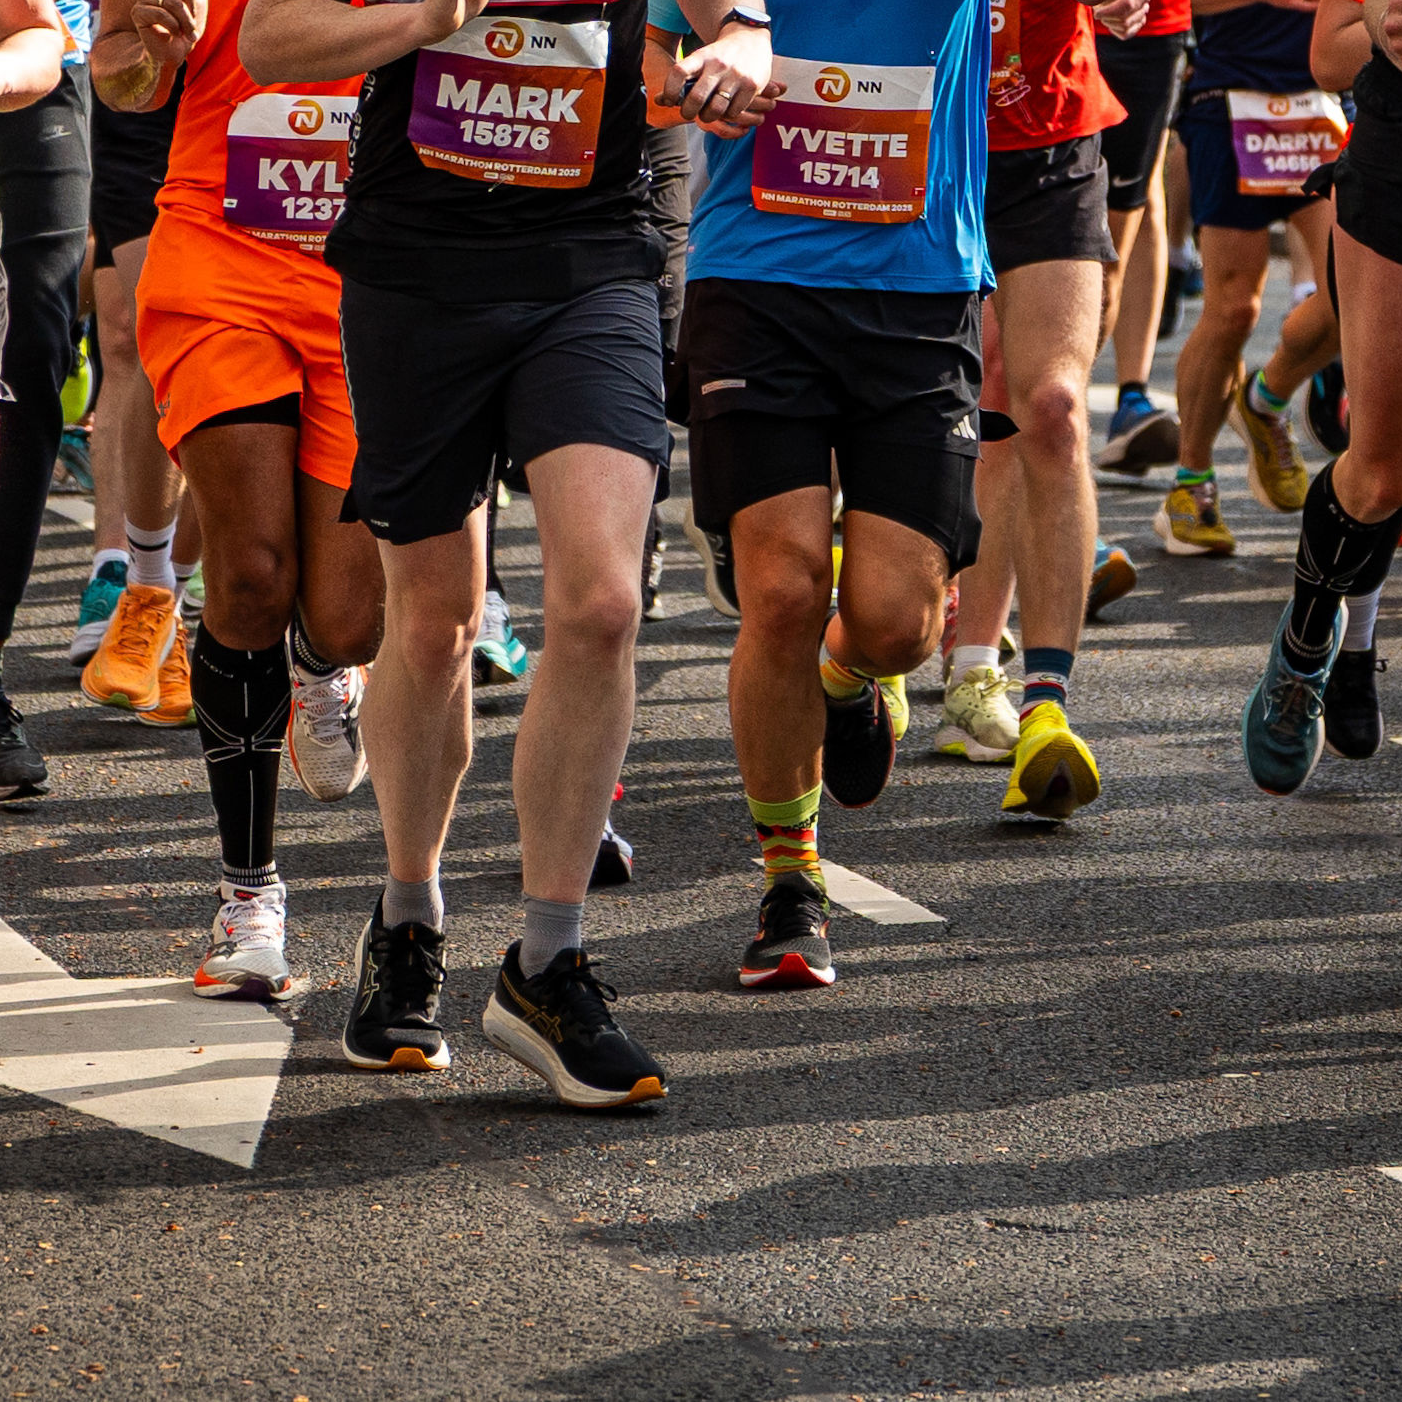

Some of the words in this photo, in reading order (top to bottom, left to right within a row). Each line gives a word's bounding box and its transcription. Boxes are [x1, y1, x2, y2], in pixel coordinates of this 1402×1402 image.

[530, 36, 557, 49] NN
[436, 73, 583, 123] MARK
[857, 80, 882, 93] NN
[459, 119, 551, 151] 15876
[776, 124, 909, 158] YVETTE
[1245, 131, 1338, 153] DARRYL
[258, 158, 344, 192] KYL
[435, 151, 494, 171] MARATHON
[494, 162, 557, 176] ROTTERDAM
[558, 168, 582, 177] 2025
[800, 161, 879, 189] 15714
[761, 192, 776, 201] NN
[776, 194, 831, 208] MARATHON
[832, 201, 890, 212] ROTTERDAM
[251, 230, 307, 243] MARATHON
